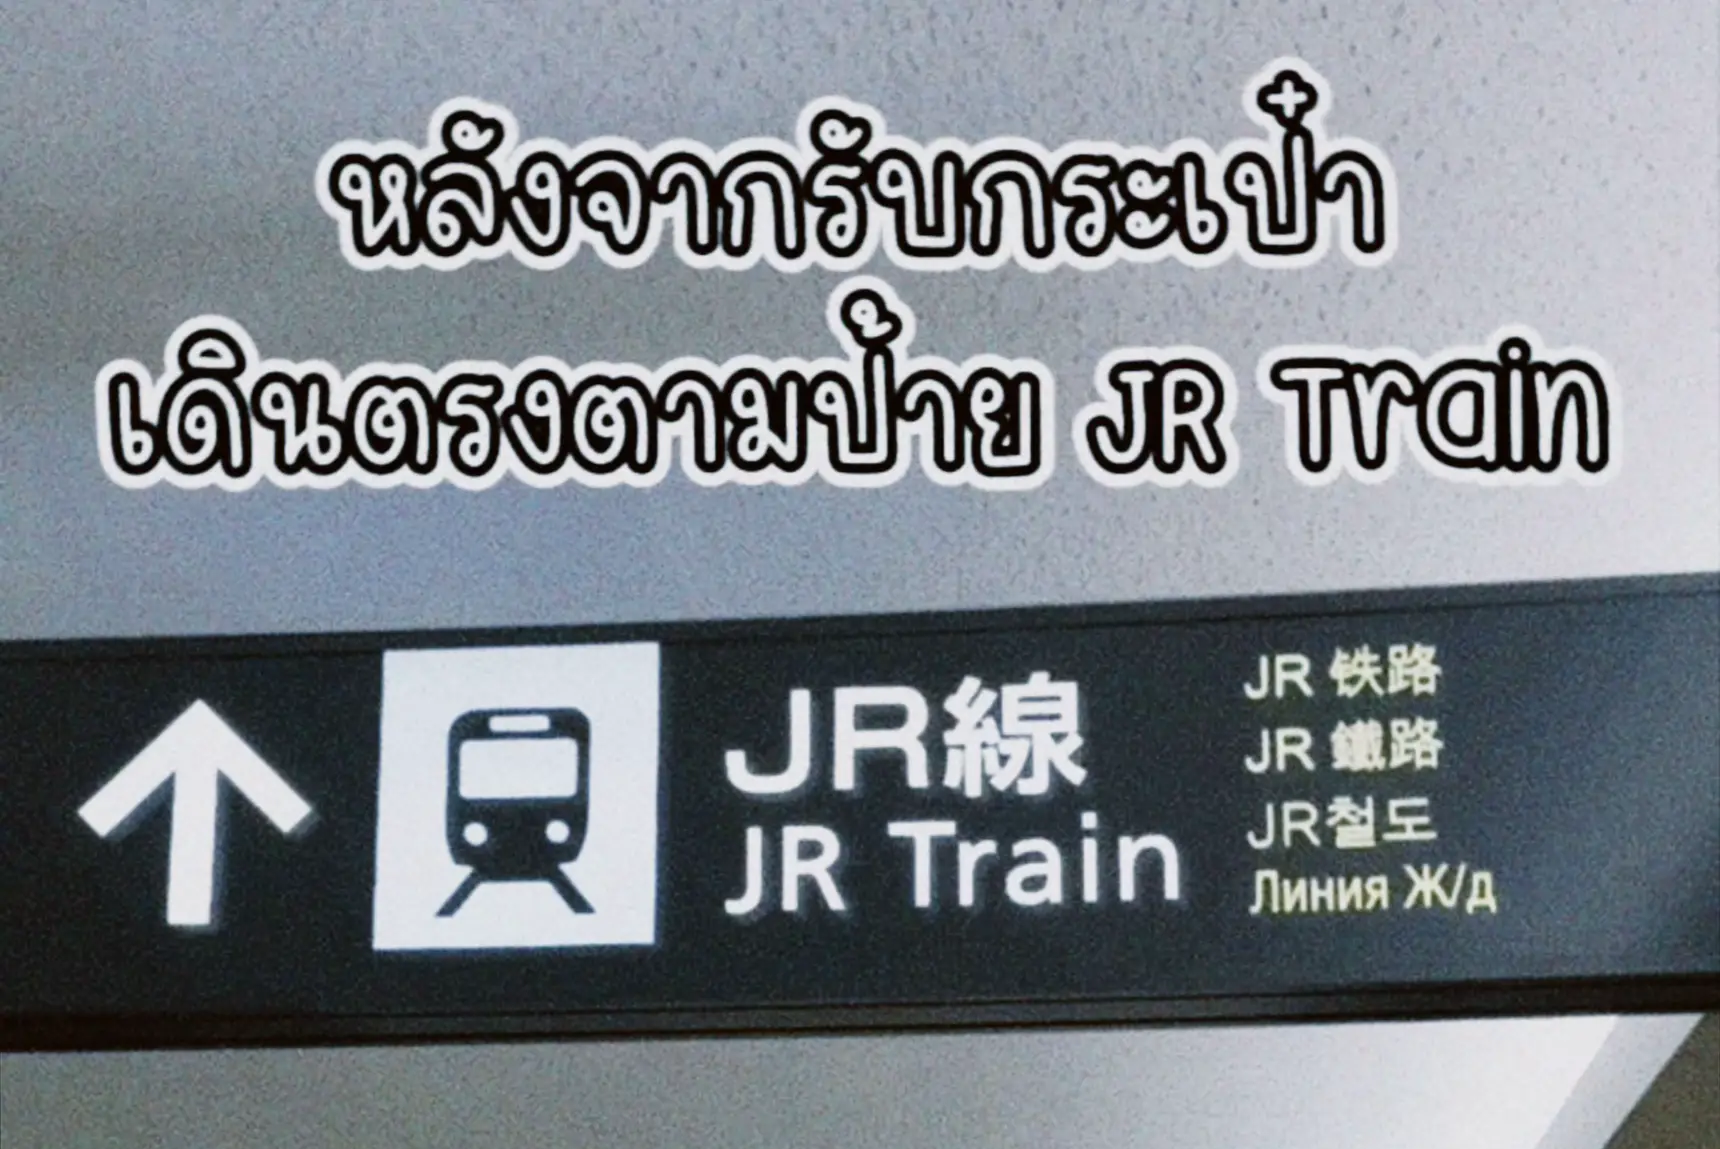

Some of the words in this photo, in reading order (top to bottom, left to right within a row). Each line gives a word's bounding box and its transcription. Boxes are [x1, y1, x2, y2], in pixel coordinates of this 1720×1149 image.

[1244, 653, 1314, 699] JR
[1329, 642, 1442, 697] 铁路
[724, 670, 1088, 798] JR線
[1245, 727, 1316, 773] JR
[724, 825, 845, 915] JR
[888, 812, 1181, 908] Train
[1249, 869, 1388, 914] Линия
